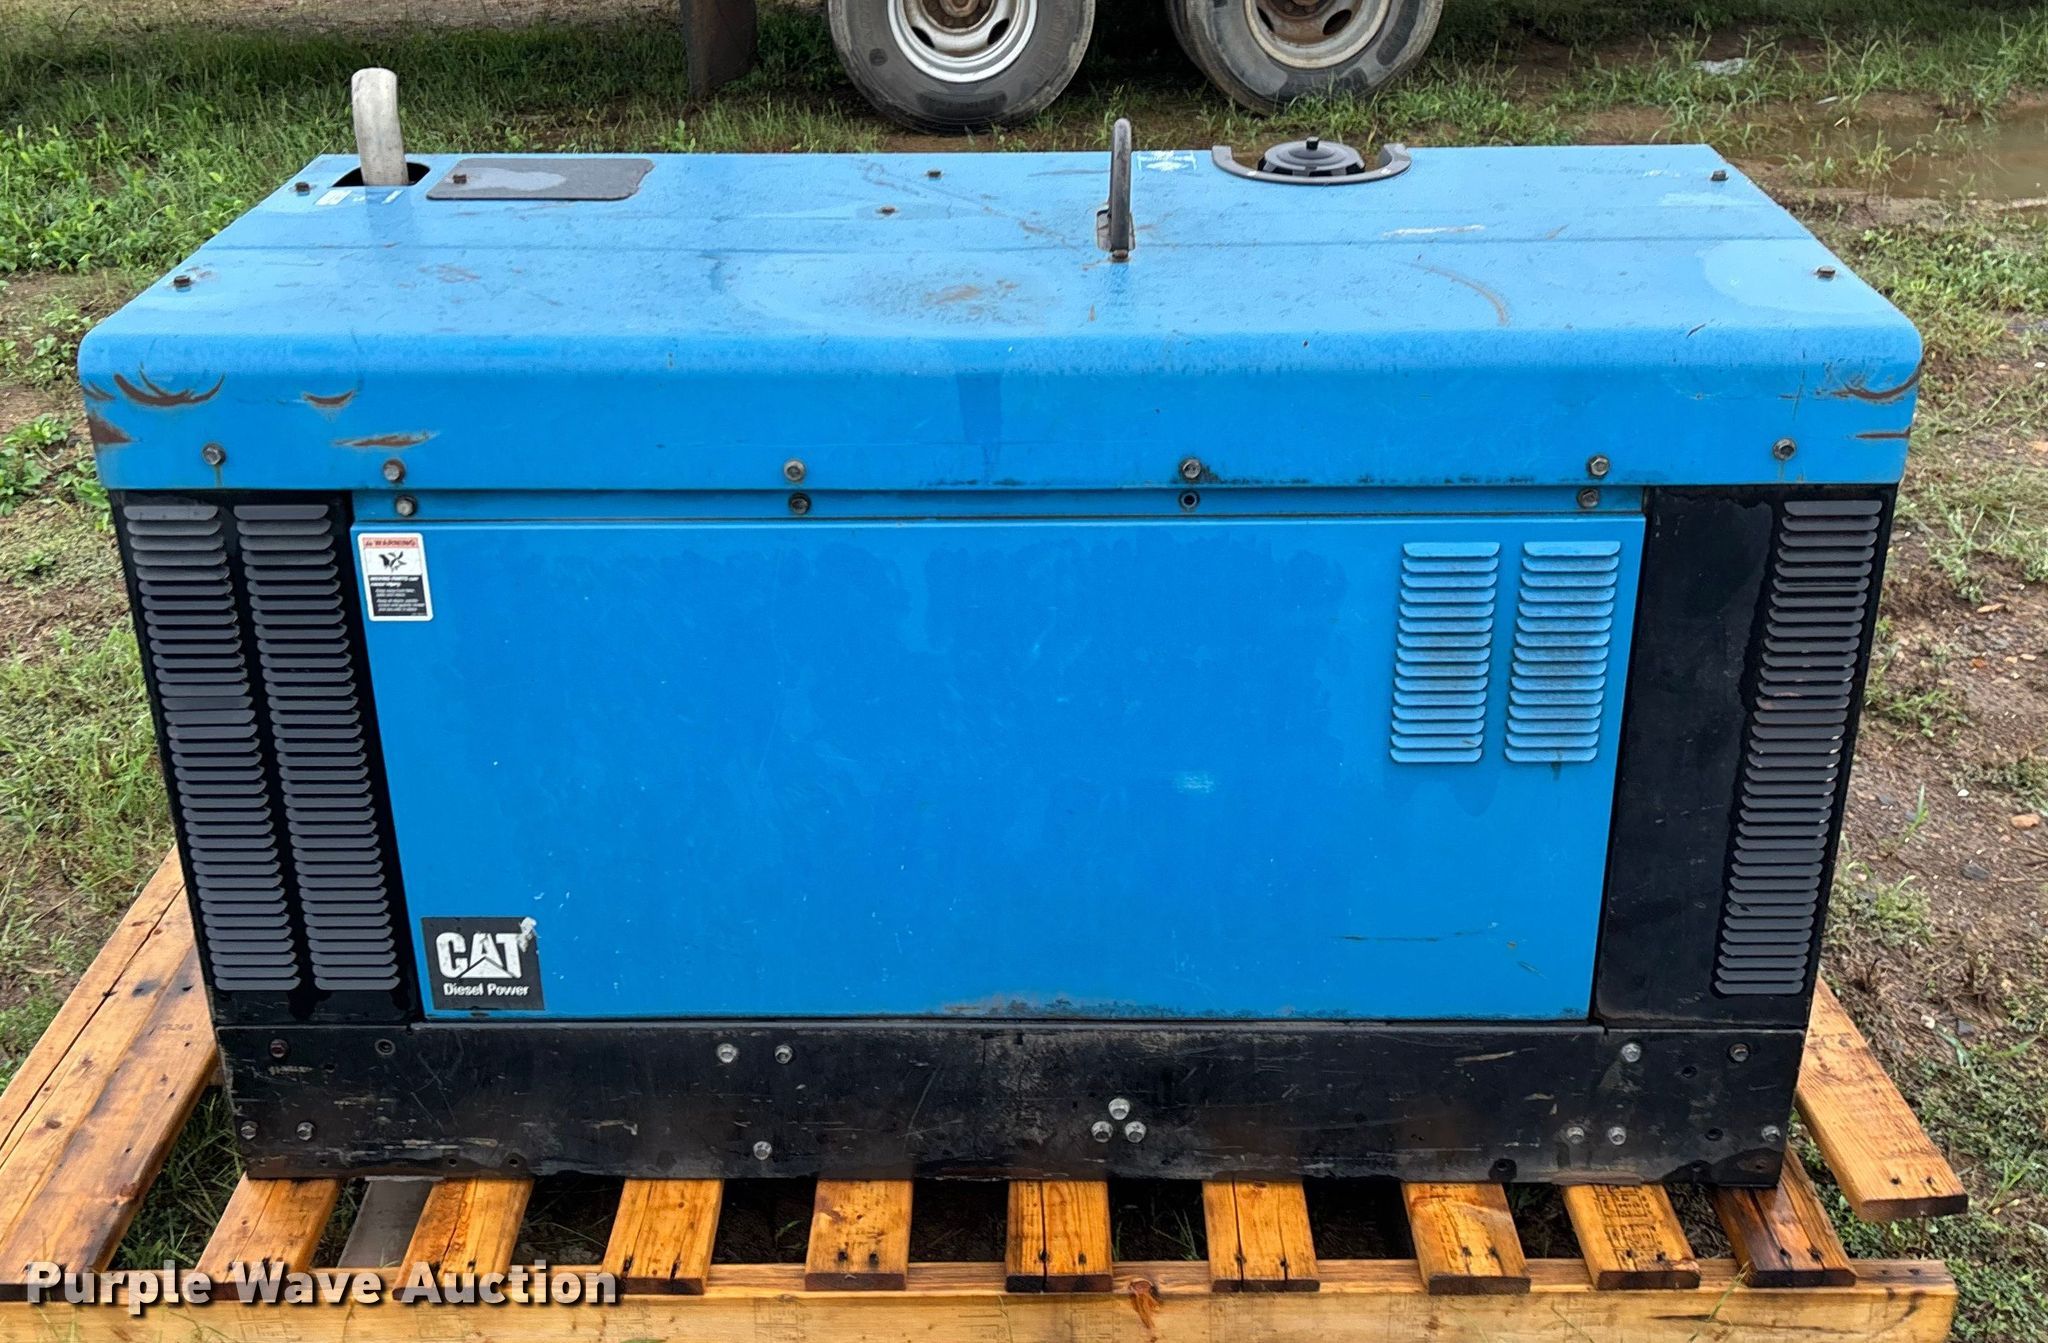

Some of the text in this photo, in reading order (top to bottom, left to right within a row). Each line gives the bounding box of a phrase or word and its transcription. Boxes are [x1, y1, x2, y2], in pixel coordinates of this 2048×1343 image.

[436, 932, 522, 979] CAT
[443, 983, 530, 996] Diesel Power
